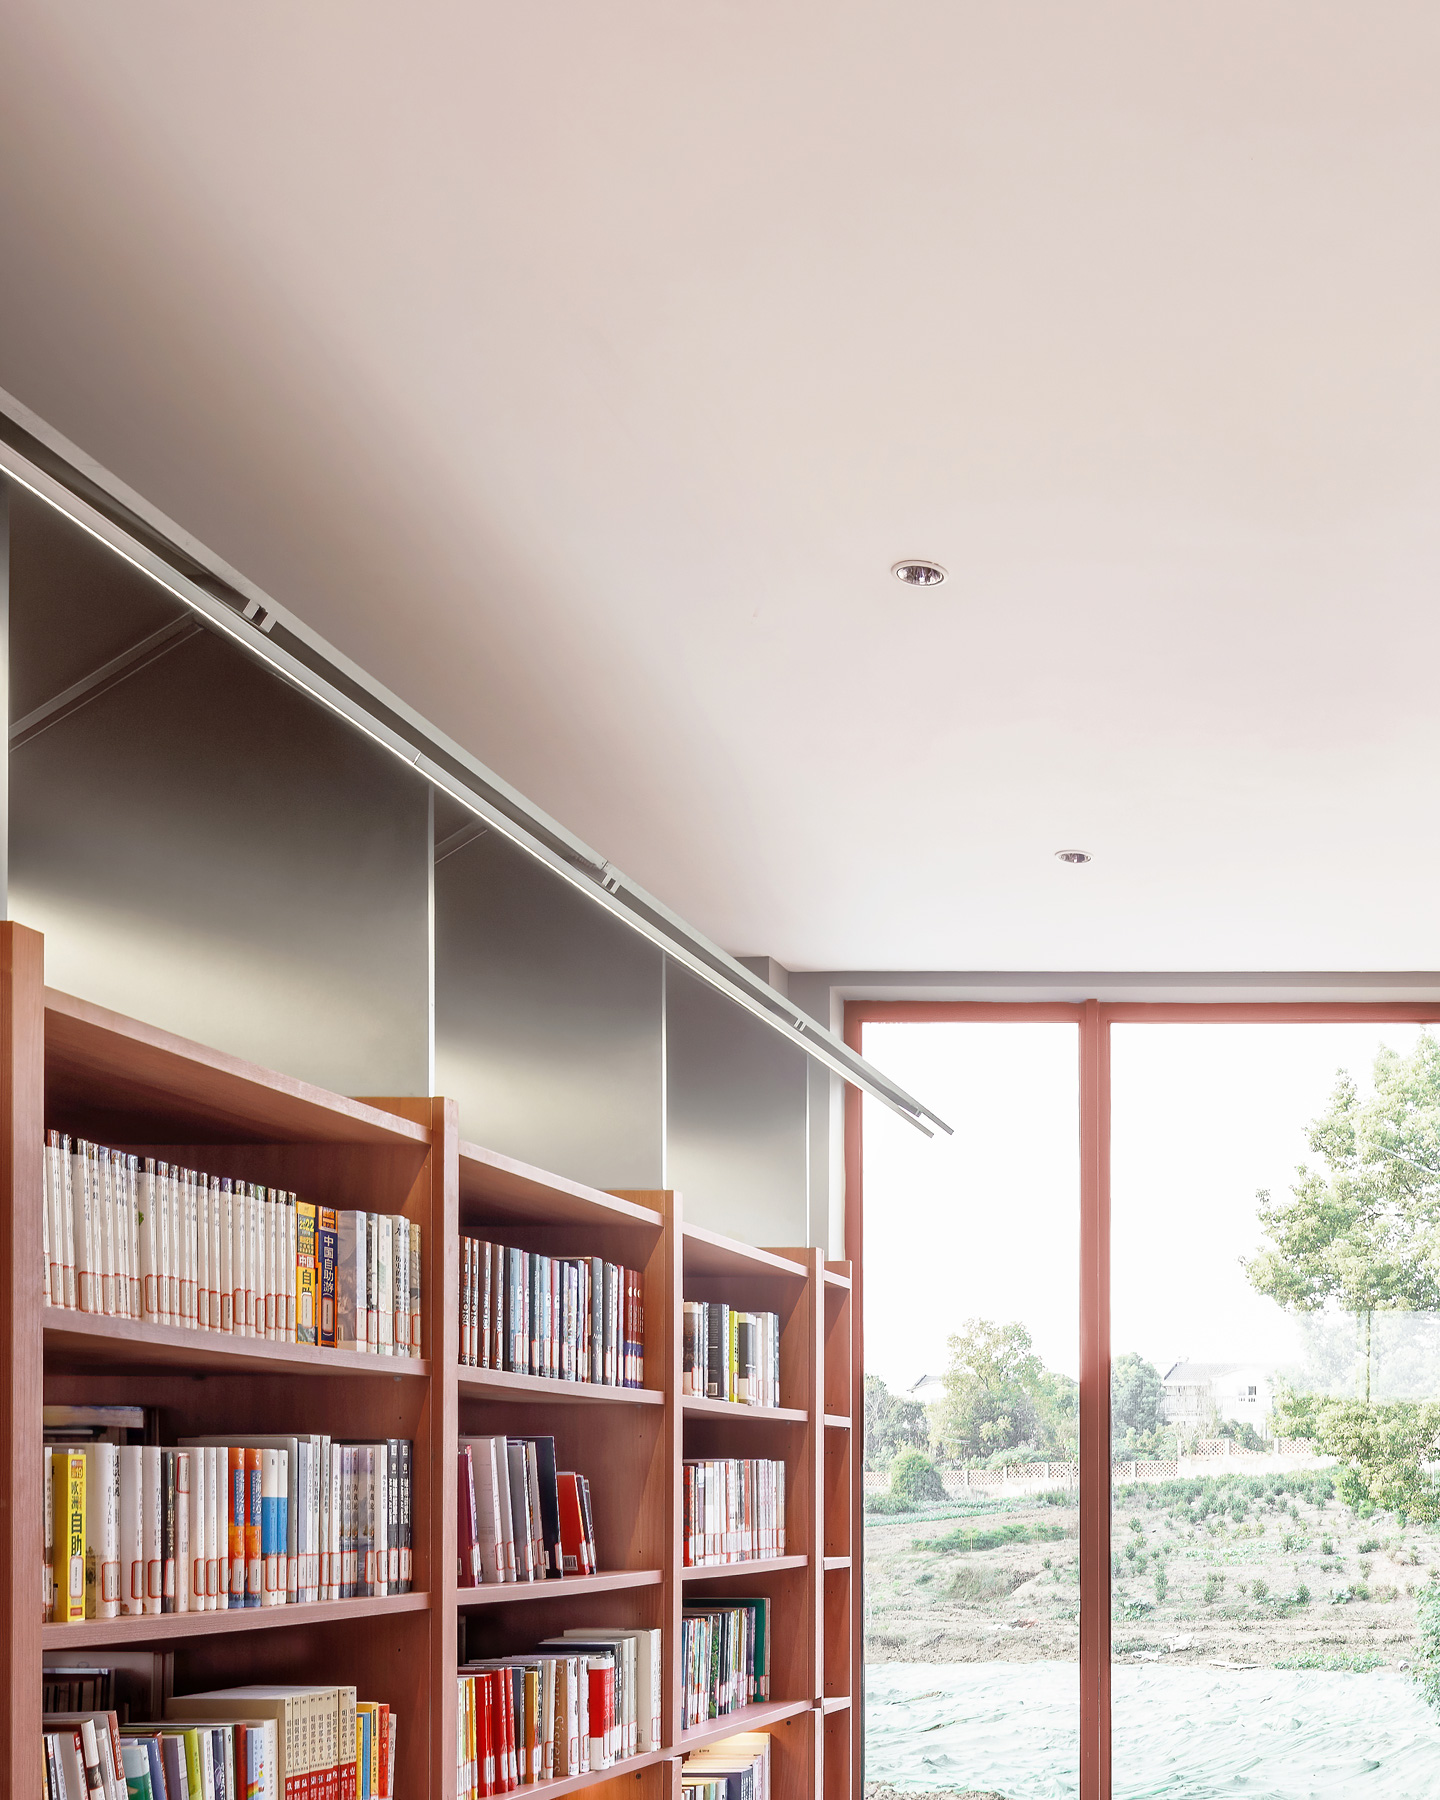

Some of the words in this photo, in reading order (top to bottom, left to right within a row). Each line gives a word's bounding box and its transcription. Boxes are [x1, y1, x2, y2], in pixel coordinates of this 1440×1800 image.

[300, 1255, 313, 1268] 中国
[324, 1235, 333, 1292] 中国自助游
